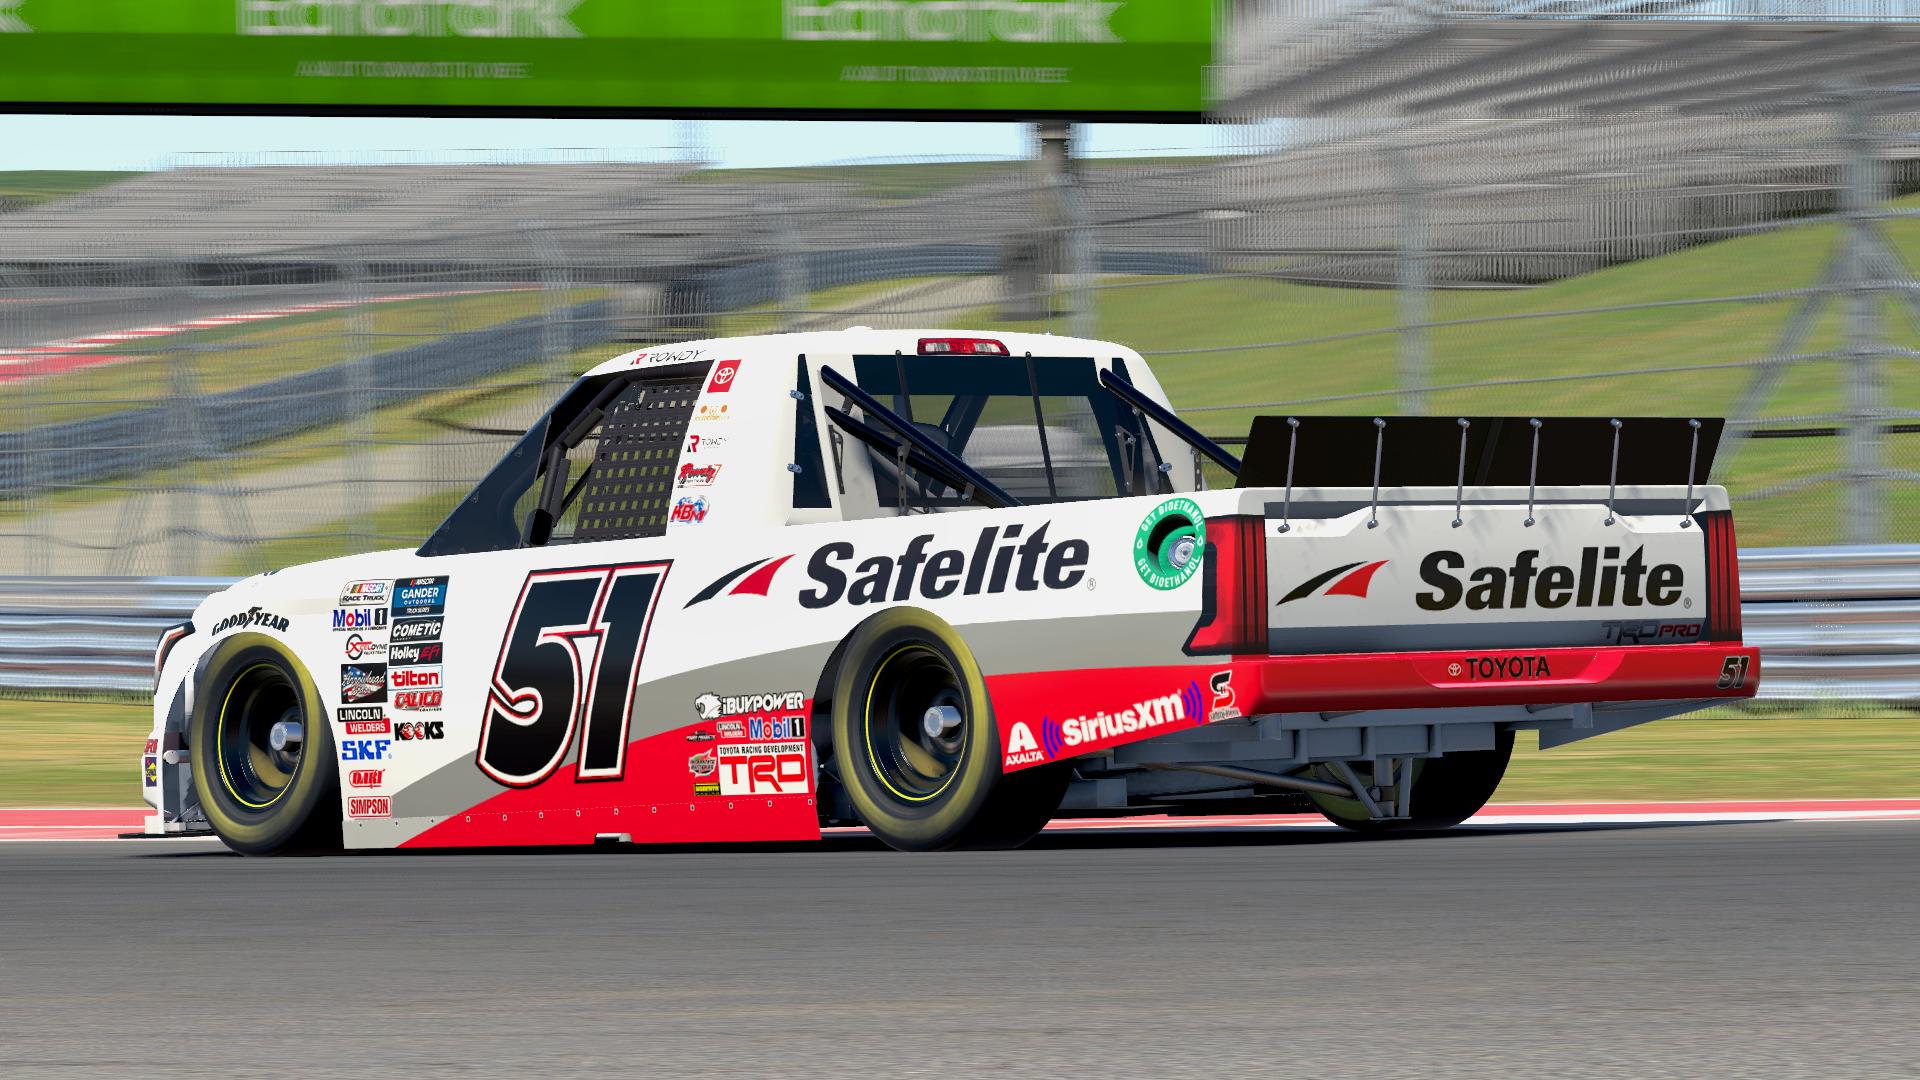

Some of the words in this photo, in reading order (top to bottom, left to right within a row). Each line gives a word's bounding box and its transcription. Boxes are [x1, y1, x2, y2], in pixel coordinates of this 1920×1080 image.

[1141, 512, 1157, 532] GET
[1158, 499, 1203, 532] BIOETHANOL
[799, 519, 1090, 609] Safelite
[1138, 558, 1151, 577] GET
[1150, 555, 1200, 588] BIOETHANOL
[1415, 543, 1684, 611] Safelite
[342, 594, 361, 602] RACE
[401, 587, 439, 599] GANDER
[212, 606, 290, 636] GOODYEAR
[333, 609, 371, 627] Mobil
[392, 622, 441, 638] COMETIC
[1601, 620, 1660, 645] TRD
[1659, 623, 1702, 637] PRO
[390, 647, 420, 662] Holley
[475, 559, 674, 789] 51
[1465, 655, 1551, 680] TOYOTA
[1716, 655, 1750, 690] 51
[391, 671, 439, 687] tilton
[394, 691, 443, 710] CALICO
[722, 691, 805, 714] iBUYPOWER
[340, 708, 381, 720] LINCOLN
[350, 723, 386, 733] WELDERS
[750, 717, 791, 740] Mobil
[342, 740, 391, 760] SKF
[719, 746, 740, 755] TOYOTA
[741, 745, 763, 754] RACING
[763, 744, 804, 754] DEVELOPMENT
[1005, 751, 1044, 766] AXALTA
[719, 754, 806, 793] TRD
[350, 798, 389, 814] SIMPSON
